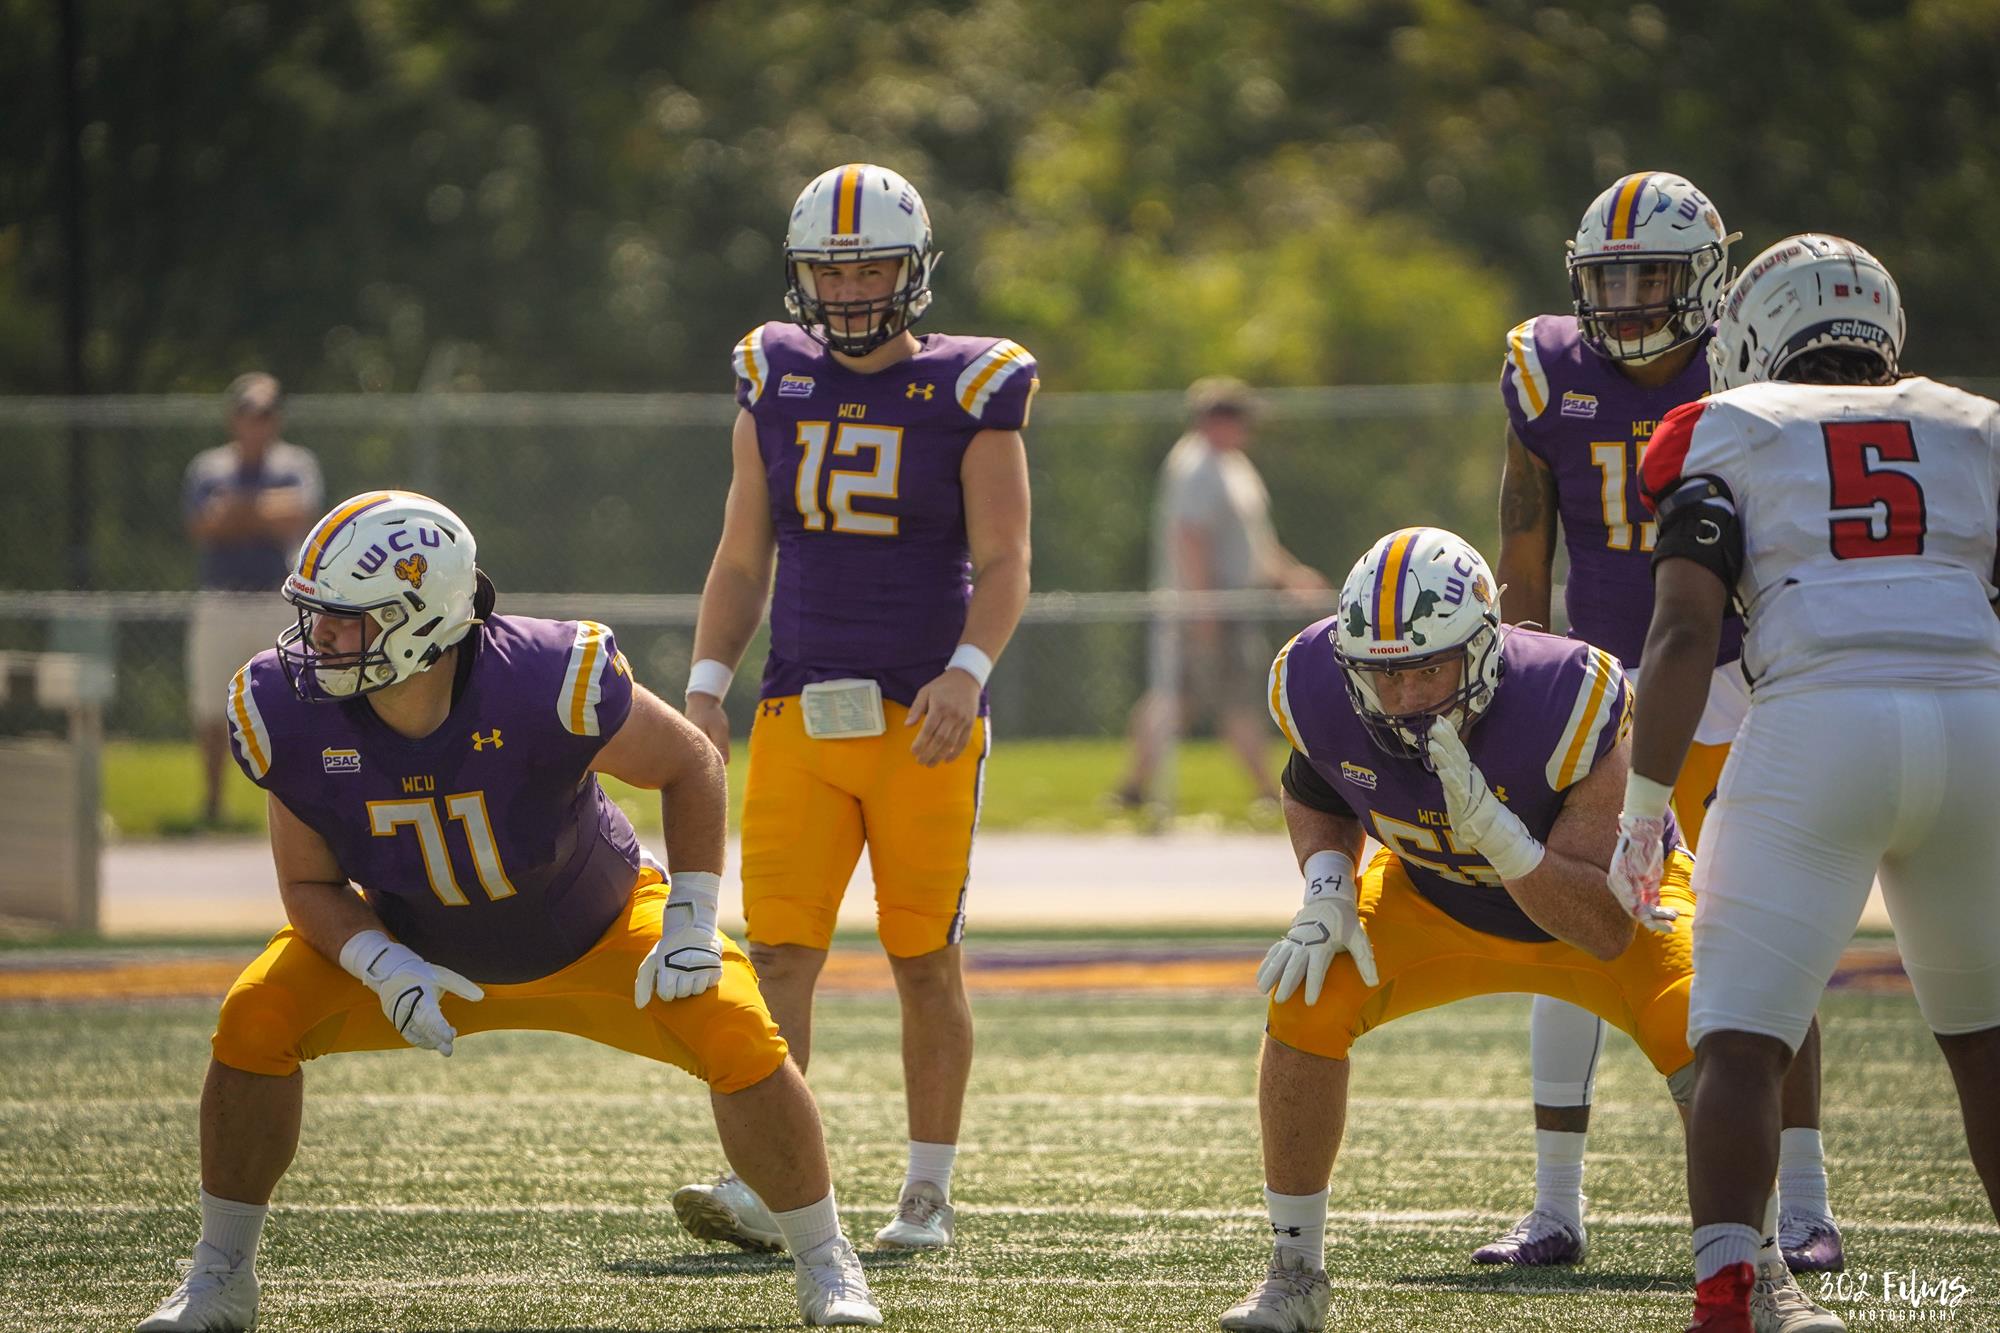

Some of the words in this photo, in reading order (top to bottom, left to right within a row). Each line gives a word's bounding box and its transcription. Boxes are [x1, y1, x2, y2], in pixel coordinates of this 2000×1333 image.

[1678, 190, 1707, 221] WC
[782, 380, 814, 391] PSAC
[837, 403, 867, 419] WCU
[1563, 399, 1597, 411] PSAC
[795, 420, 904, 536] 12
[1820, 420, 1928, 560] 5
[357, 527, 440, 574] WCU
[1443, 542, 1482, 606] WCU
[1368, 645, 1410, 655] Riddell
[324, 755, 359, 767] PSAC
[402, 775, 435, 793] WCU
[1343, 767, 1377, 784] PSAC
[1417, 808, 1452, 827] WCU
[366, 790, 517, 906] 71
[1311, 875, 1342, 896] 54
